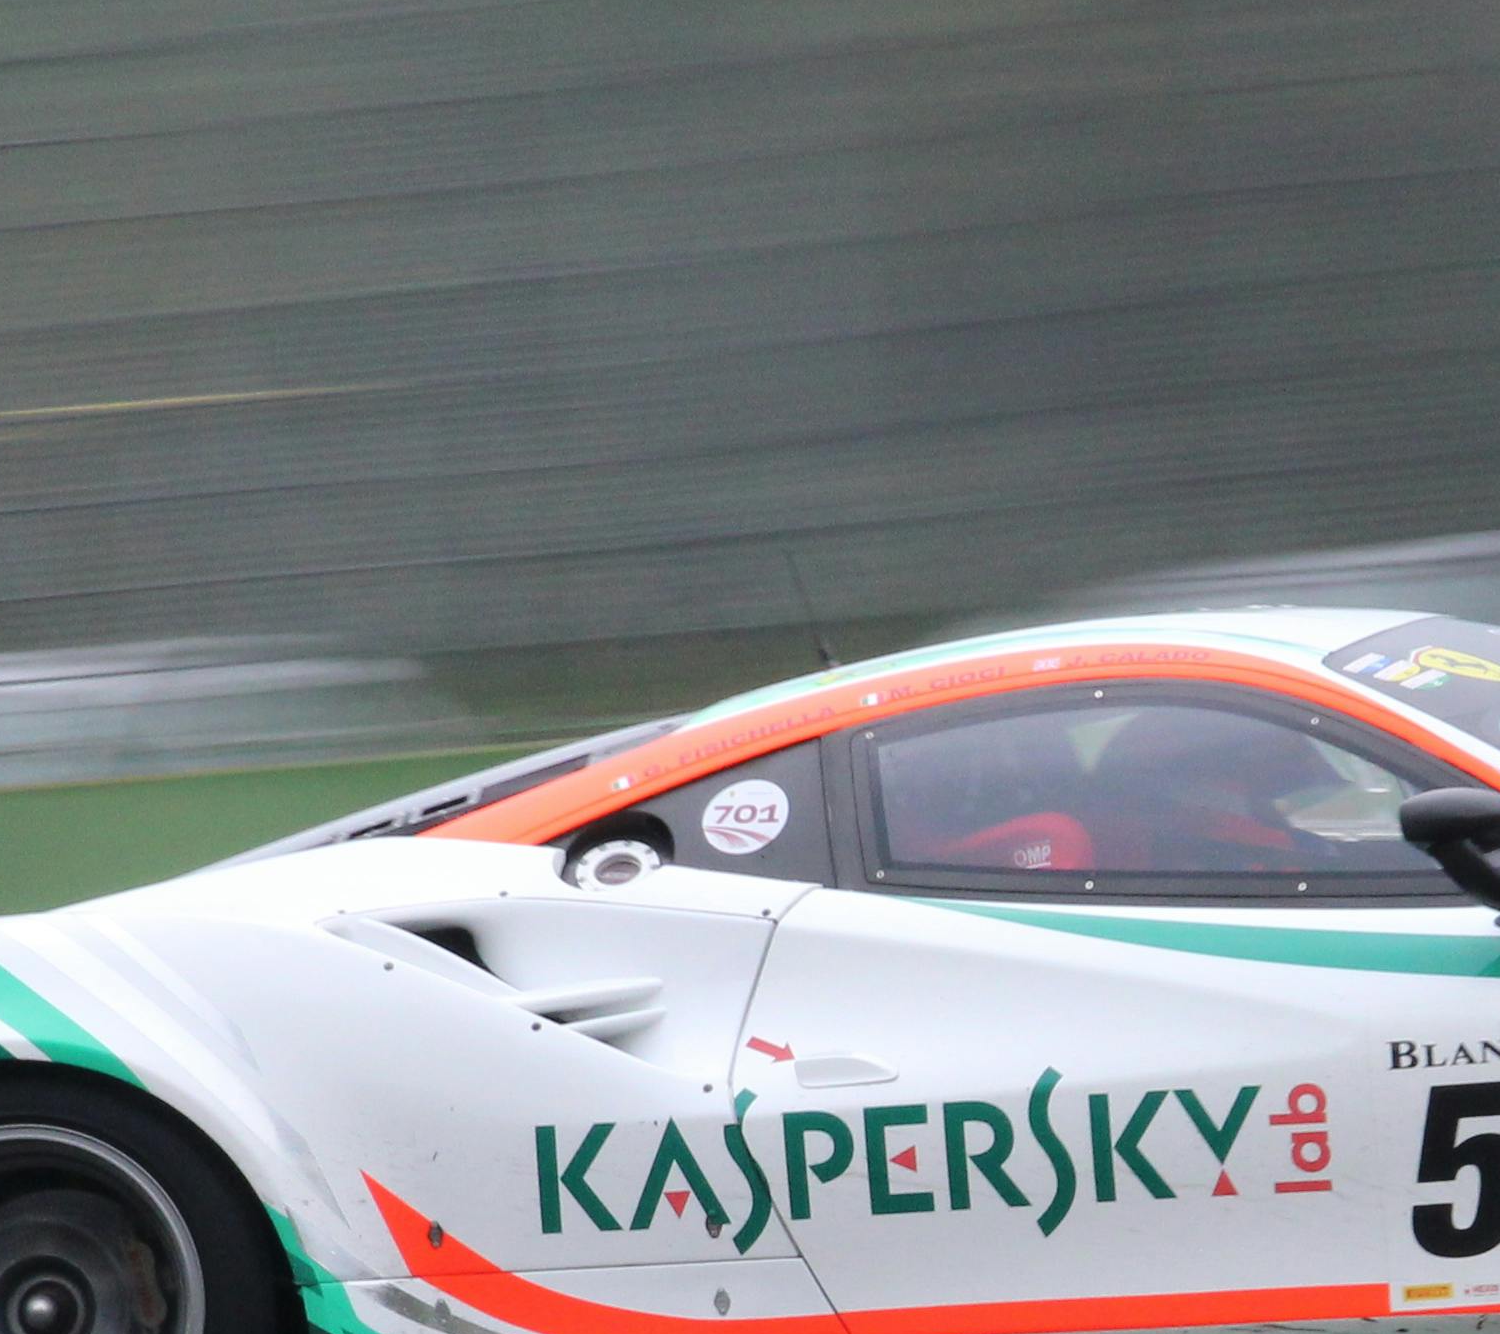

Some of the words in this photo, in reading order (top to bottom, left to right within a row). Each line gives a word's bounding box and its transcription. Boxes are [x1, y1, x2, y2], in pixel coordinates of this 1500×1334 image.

[713, 803, 780, 825] 701
[1013, 843, 1052, 869] OMP
[535, 1066, 1260, 1255] KASPERSKY
[1268, 1081, 1333, 1194] lab
